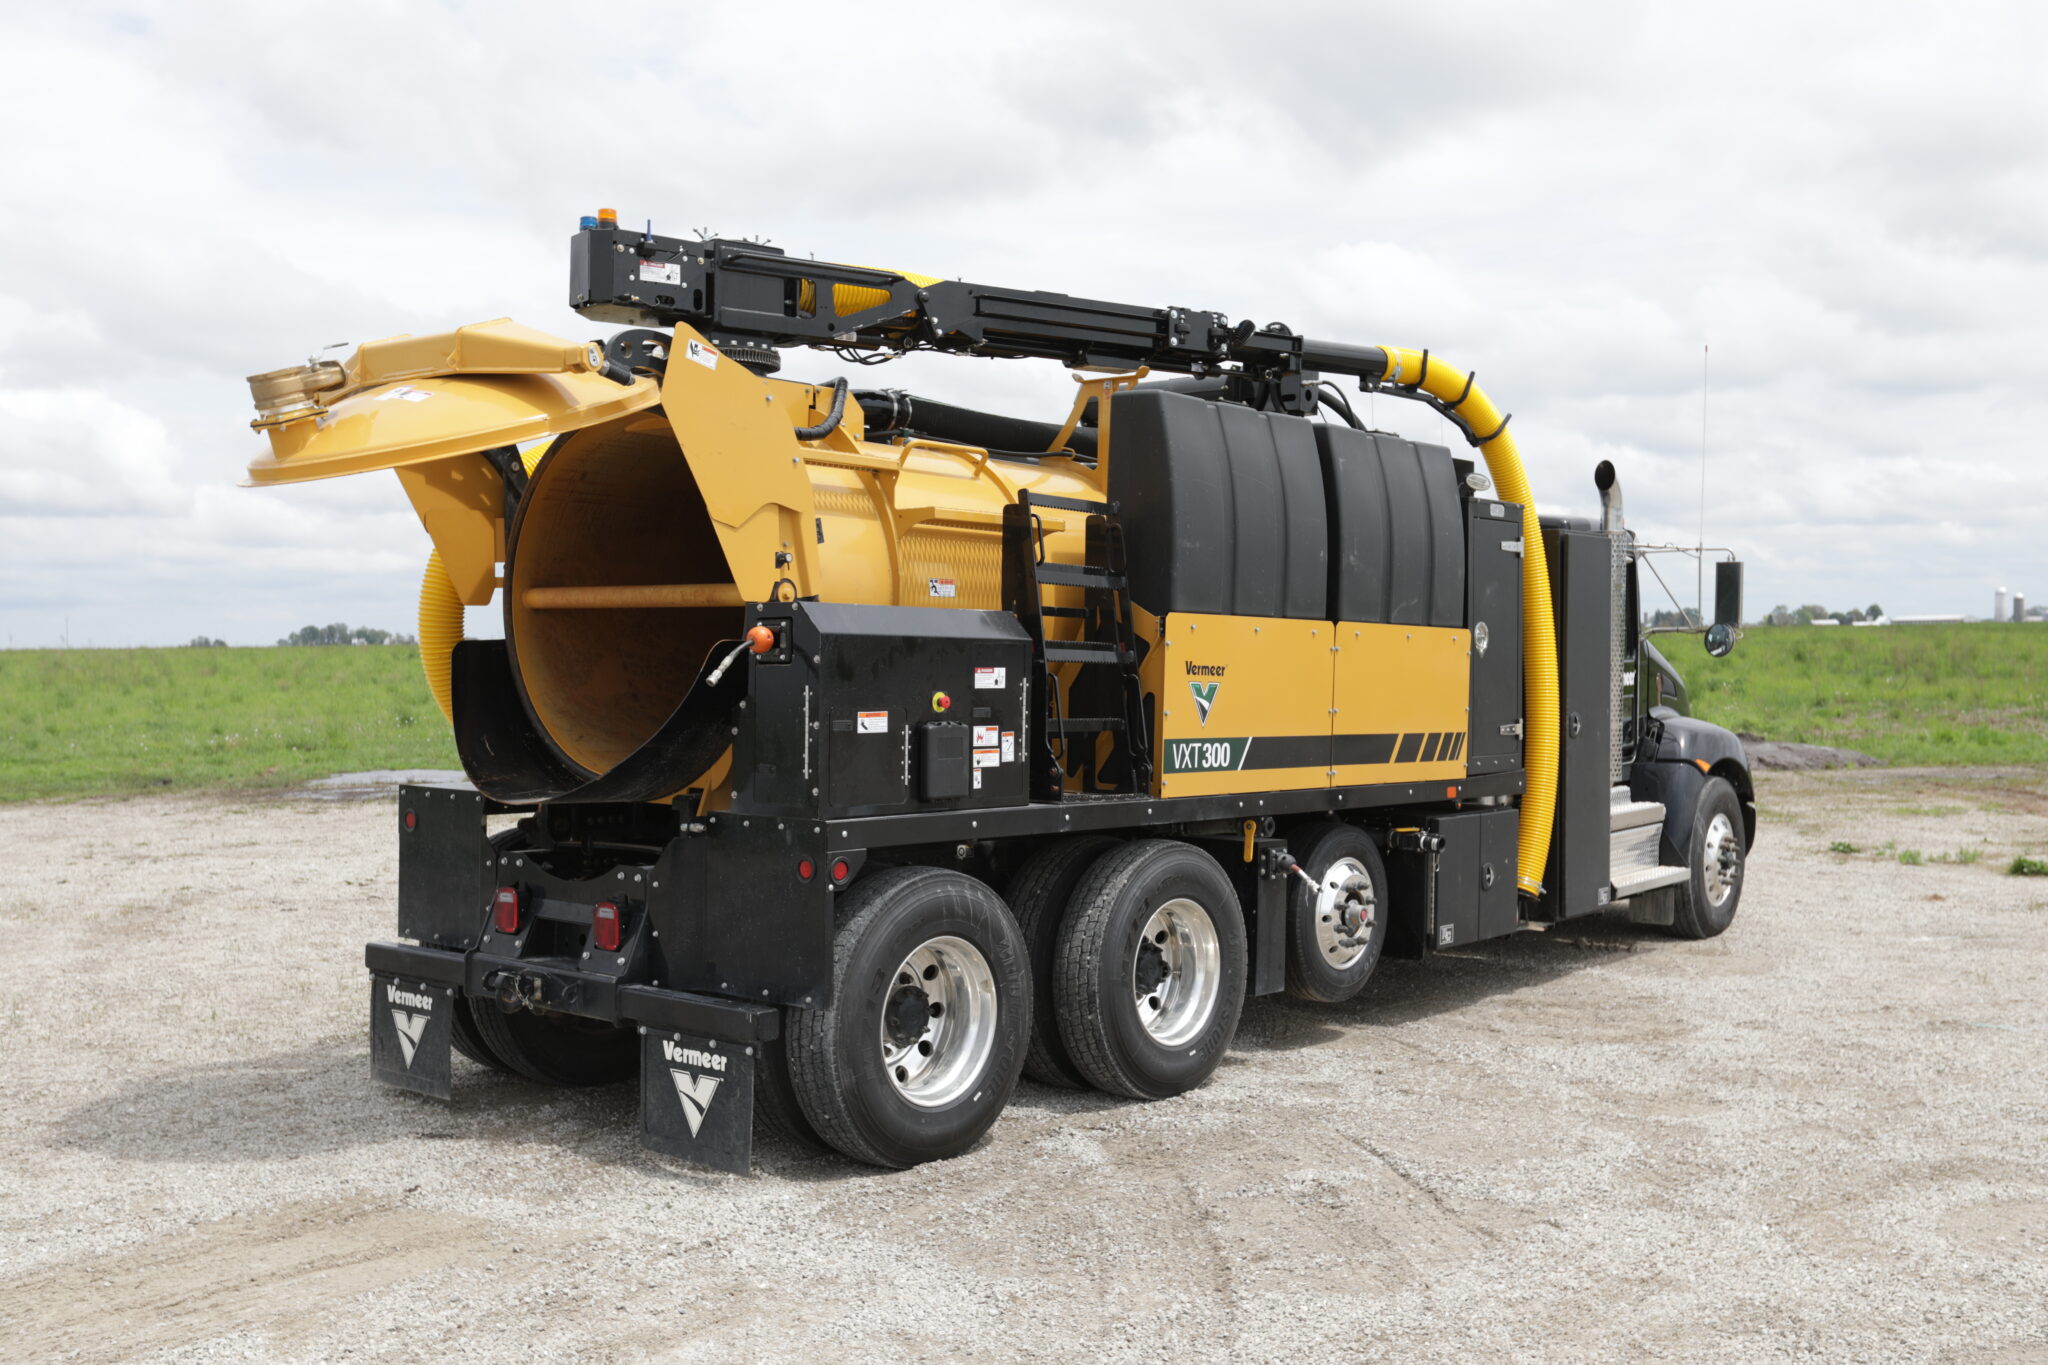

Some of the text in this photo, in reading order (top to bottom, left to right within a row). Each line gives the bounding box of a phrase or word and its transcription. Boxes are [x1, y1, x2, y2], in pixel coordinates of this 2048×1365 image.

[1185, 660, 1225, 676] Vermeer
[1172, 742, 1231, 769] VXT300
[386, 984, 433, 1011] Vermeer
[662, 1039, 727, 1072] Vermeer
